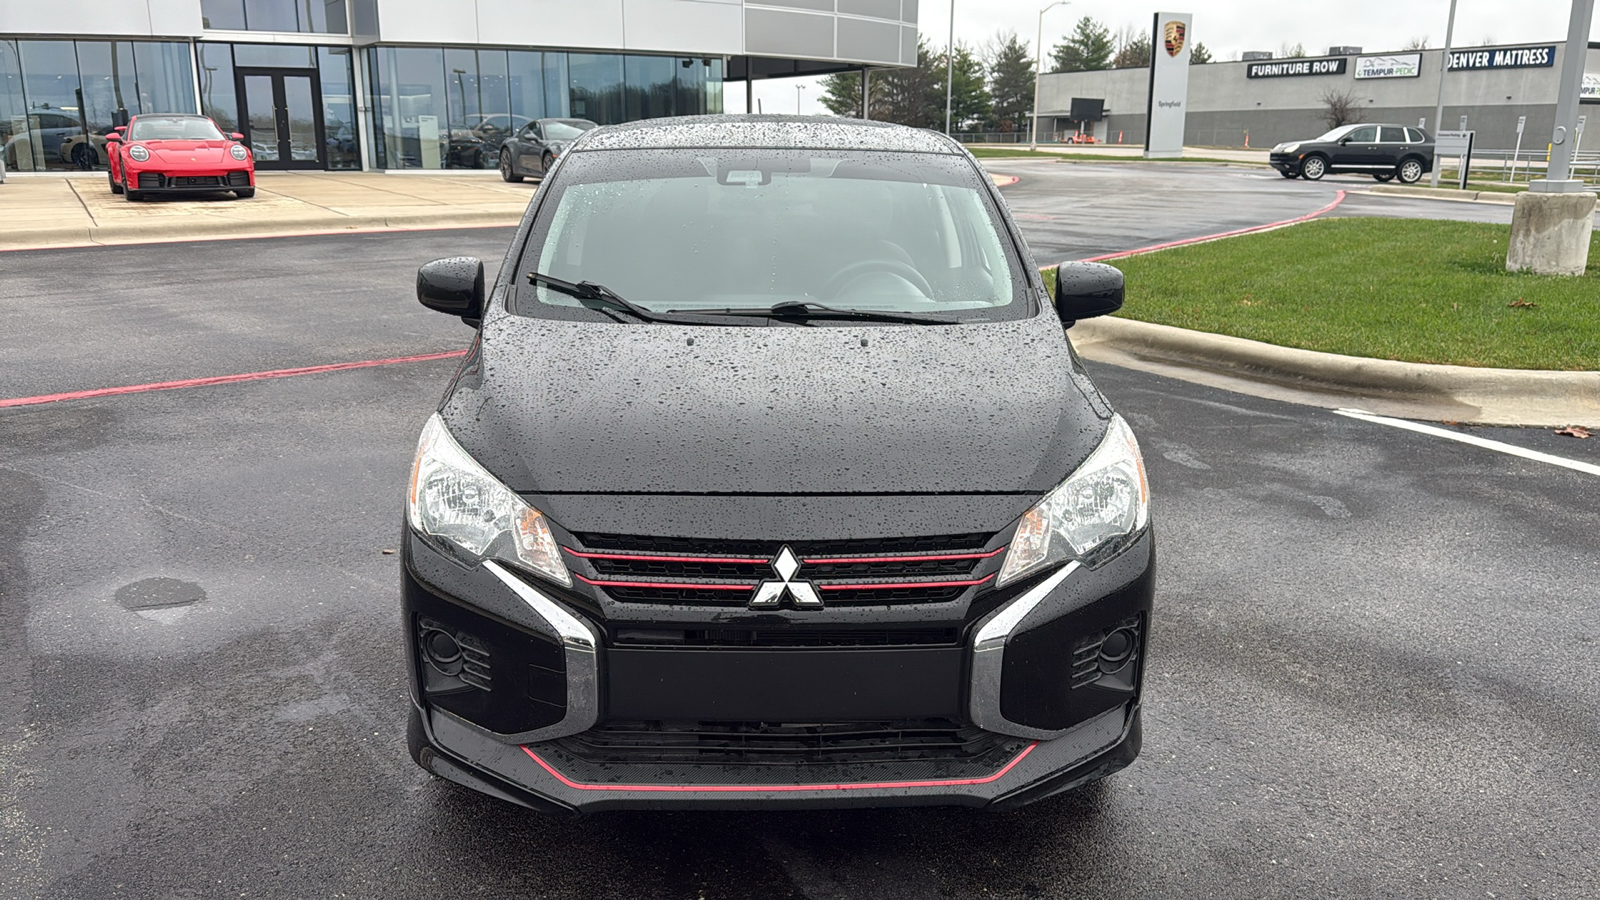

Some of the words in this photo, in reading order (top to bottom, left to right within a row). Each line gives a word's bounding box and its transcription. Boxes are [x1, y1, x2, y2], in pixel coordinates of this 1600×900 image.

[1493, 48, 1549, 66] MATTRESS
[1251, 62, 1310, 76] FURNITURE
[1312, 60, 1340, 73] ROW
[1158, 100, 1181, 108] Springfield
